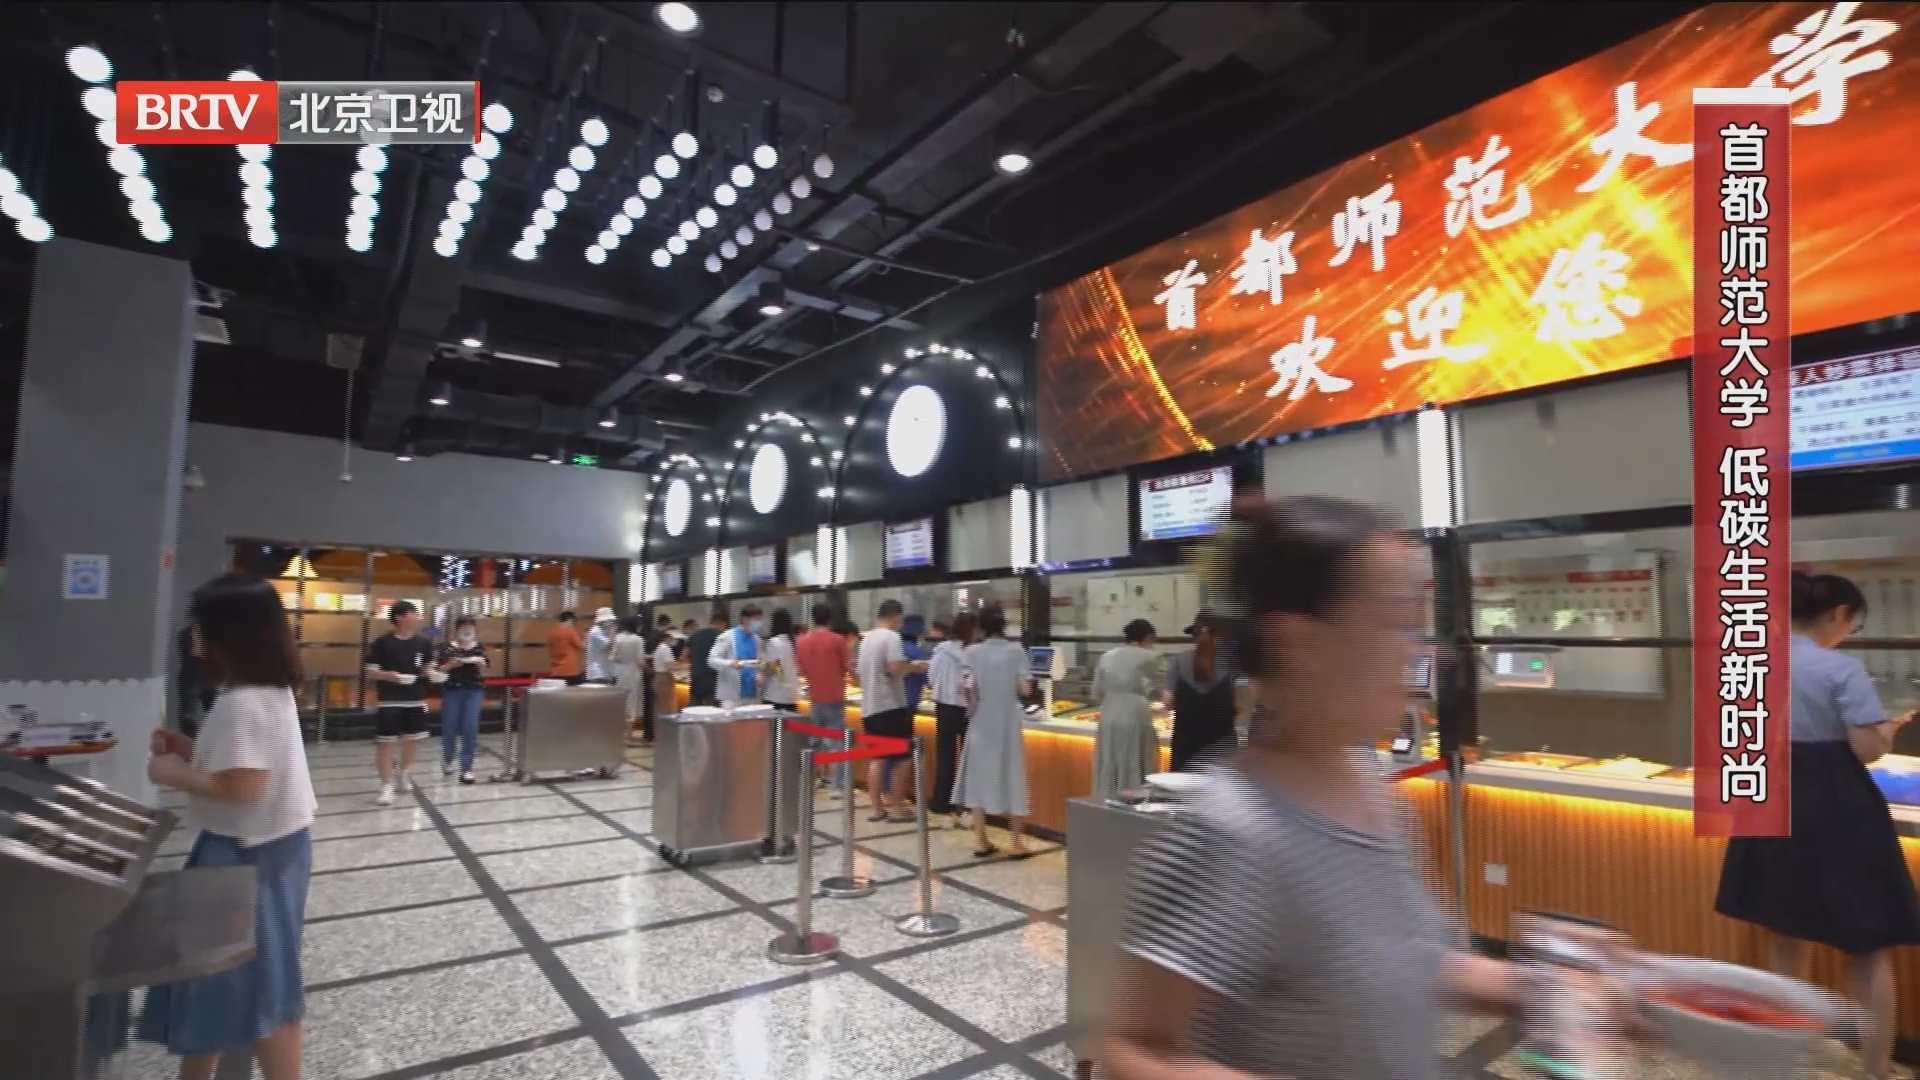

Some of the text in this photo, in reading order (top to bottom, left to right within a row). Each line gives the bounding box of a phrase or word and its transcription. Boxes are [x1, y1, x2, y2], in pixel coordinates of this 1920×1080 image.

[1153, 2, 1900, 329] 首都师范大学
[1265, 232, 1641, 400] 欢迎您
